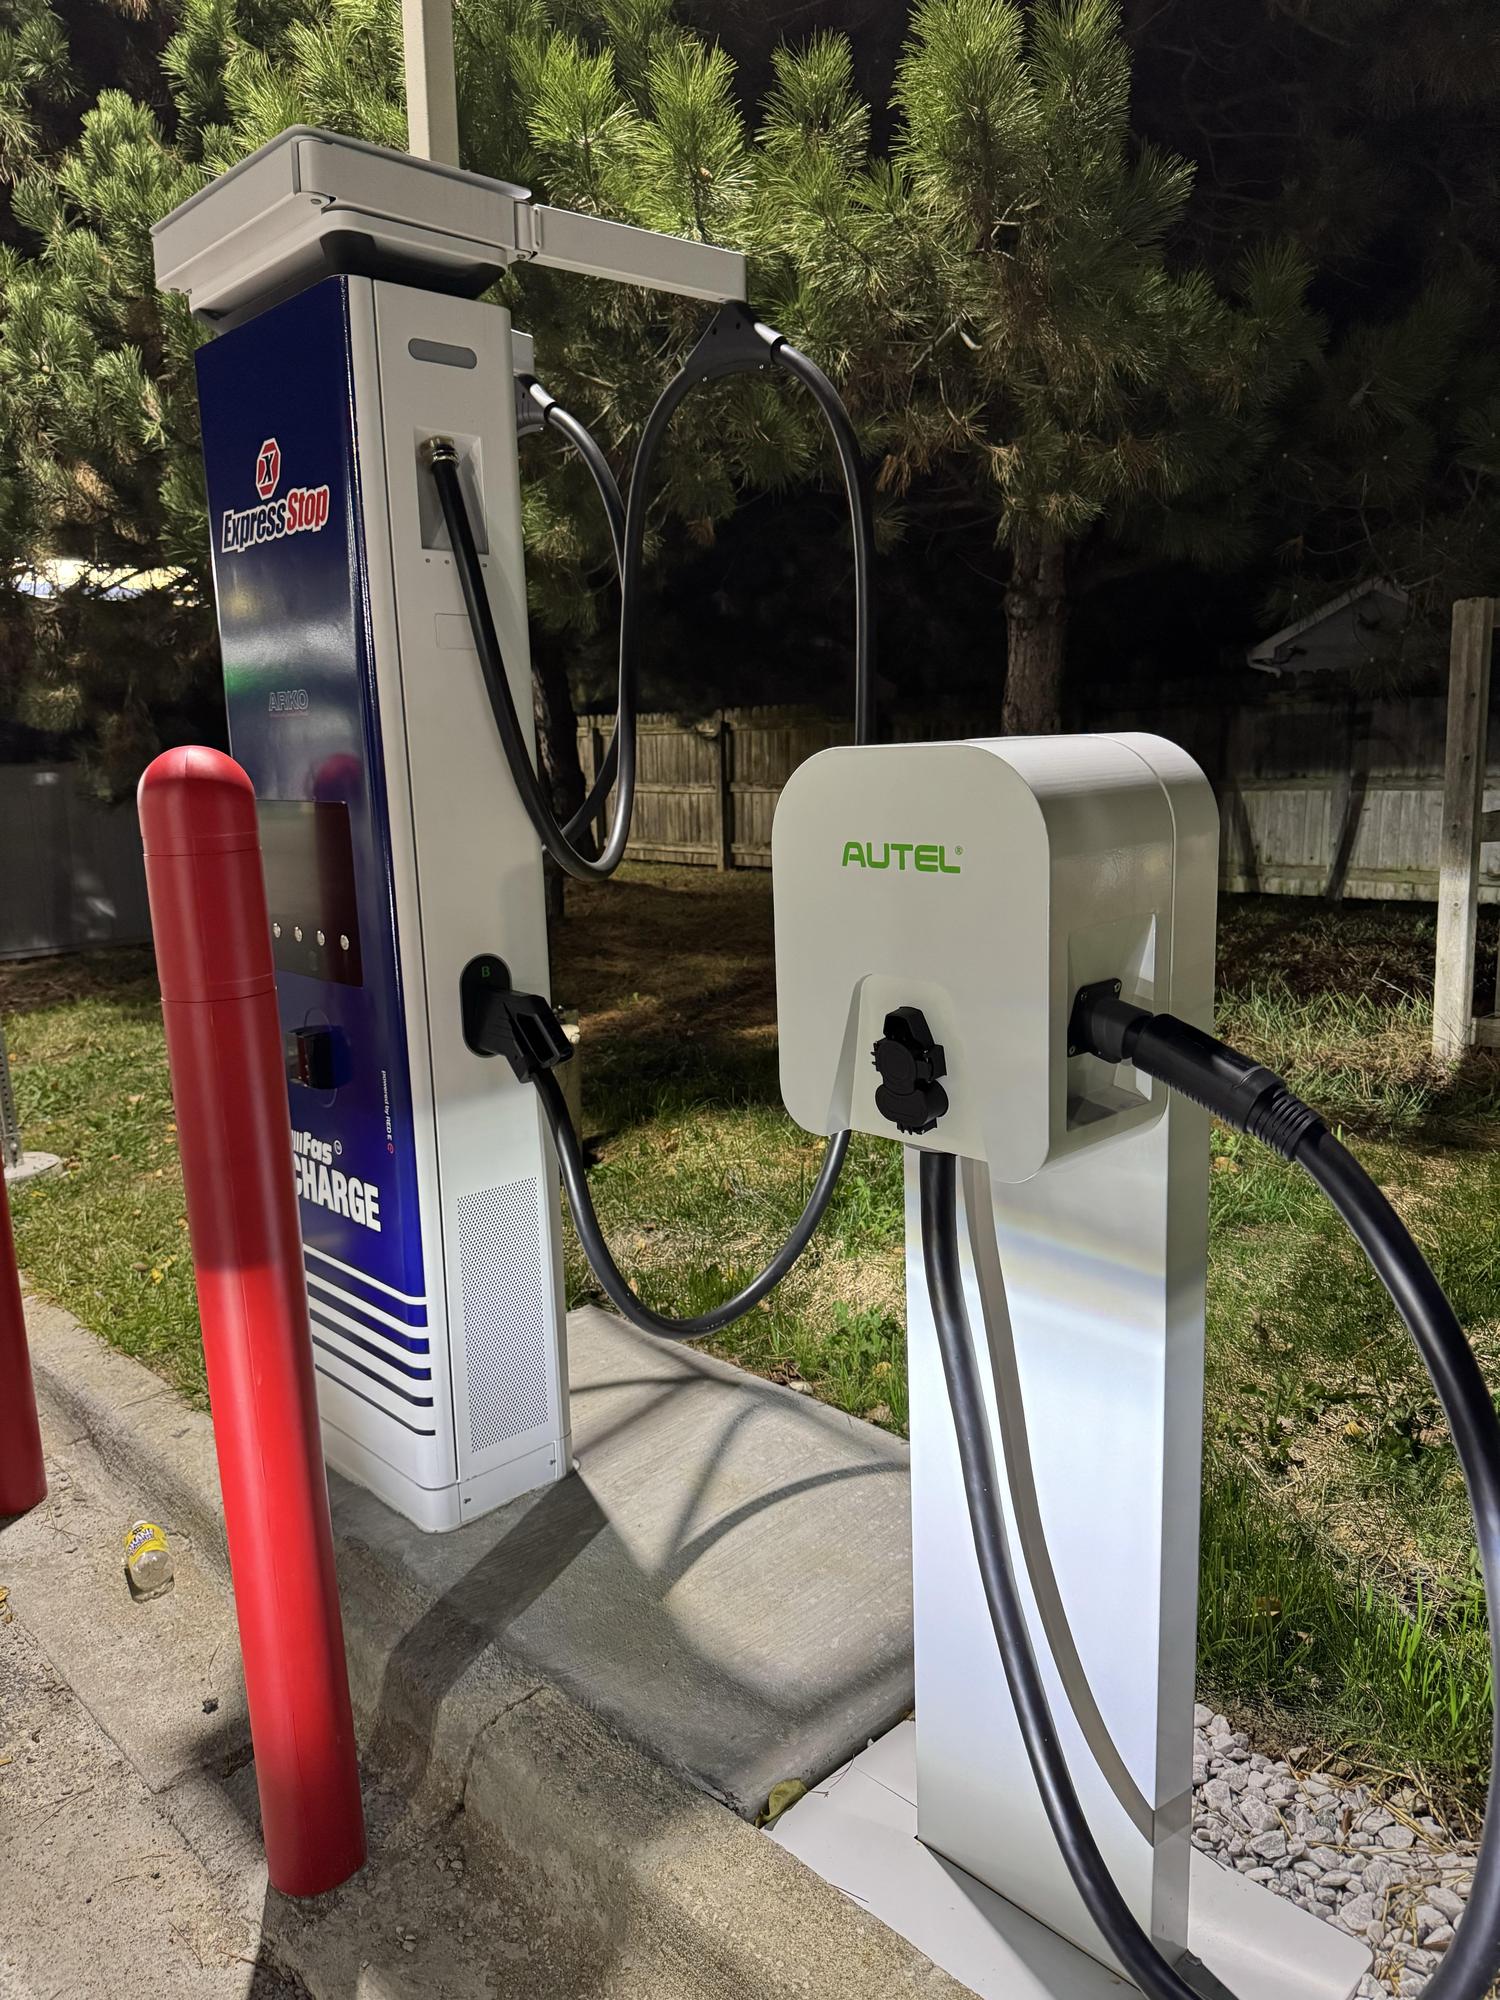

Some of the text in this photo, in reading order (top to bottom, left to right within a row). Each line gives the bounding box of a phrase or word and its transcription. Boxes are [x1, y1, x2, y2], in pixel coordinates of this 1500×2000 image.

[269, 689, 309, 712] ARKO
[481, 966, 491, 977] B
[381, 1070, 389, 1105] powered
